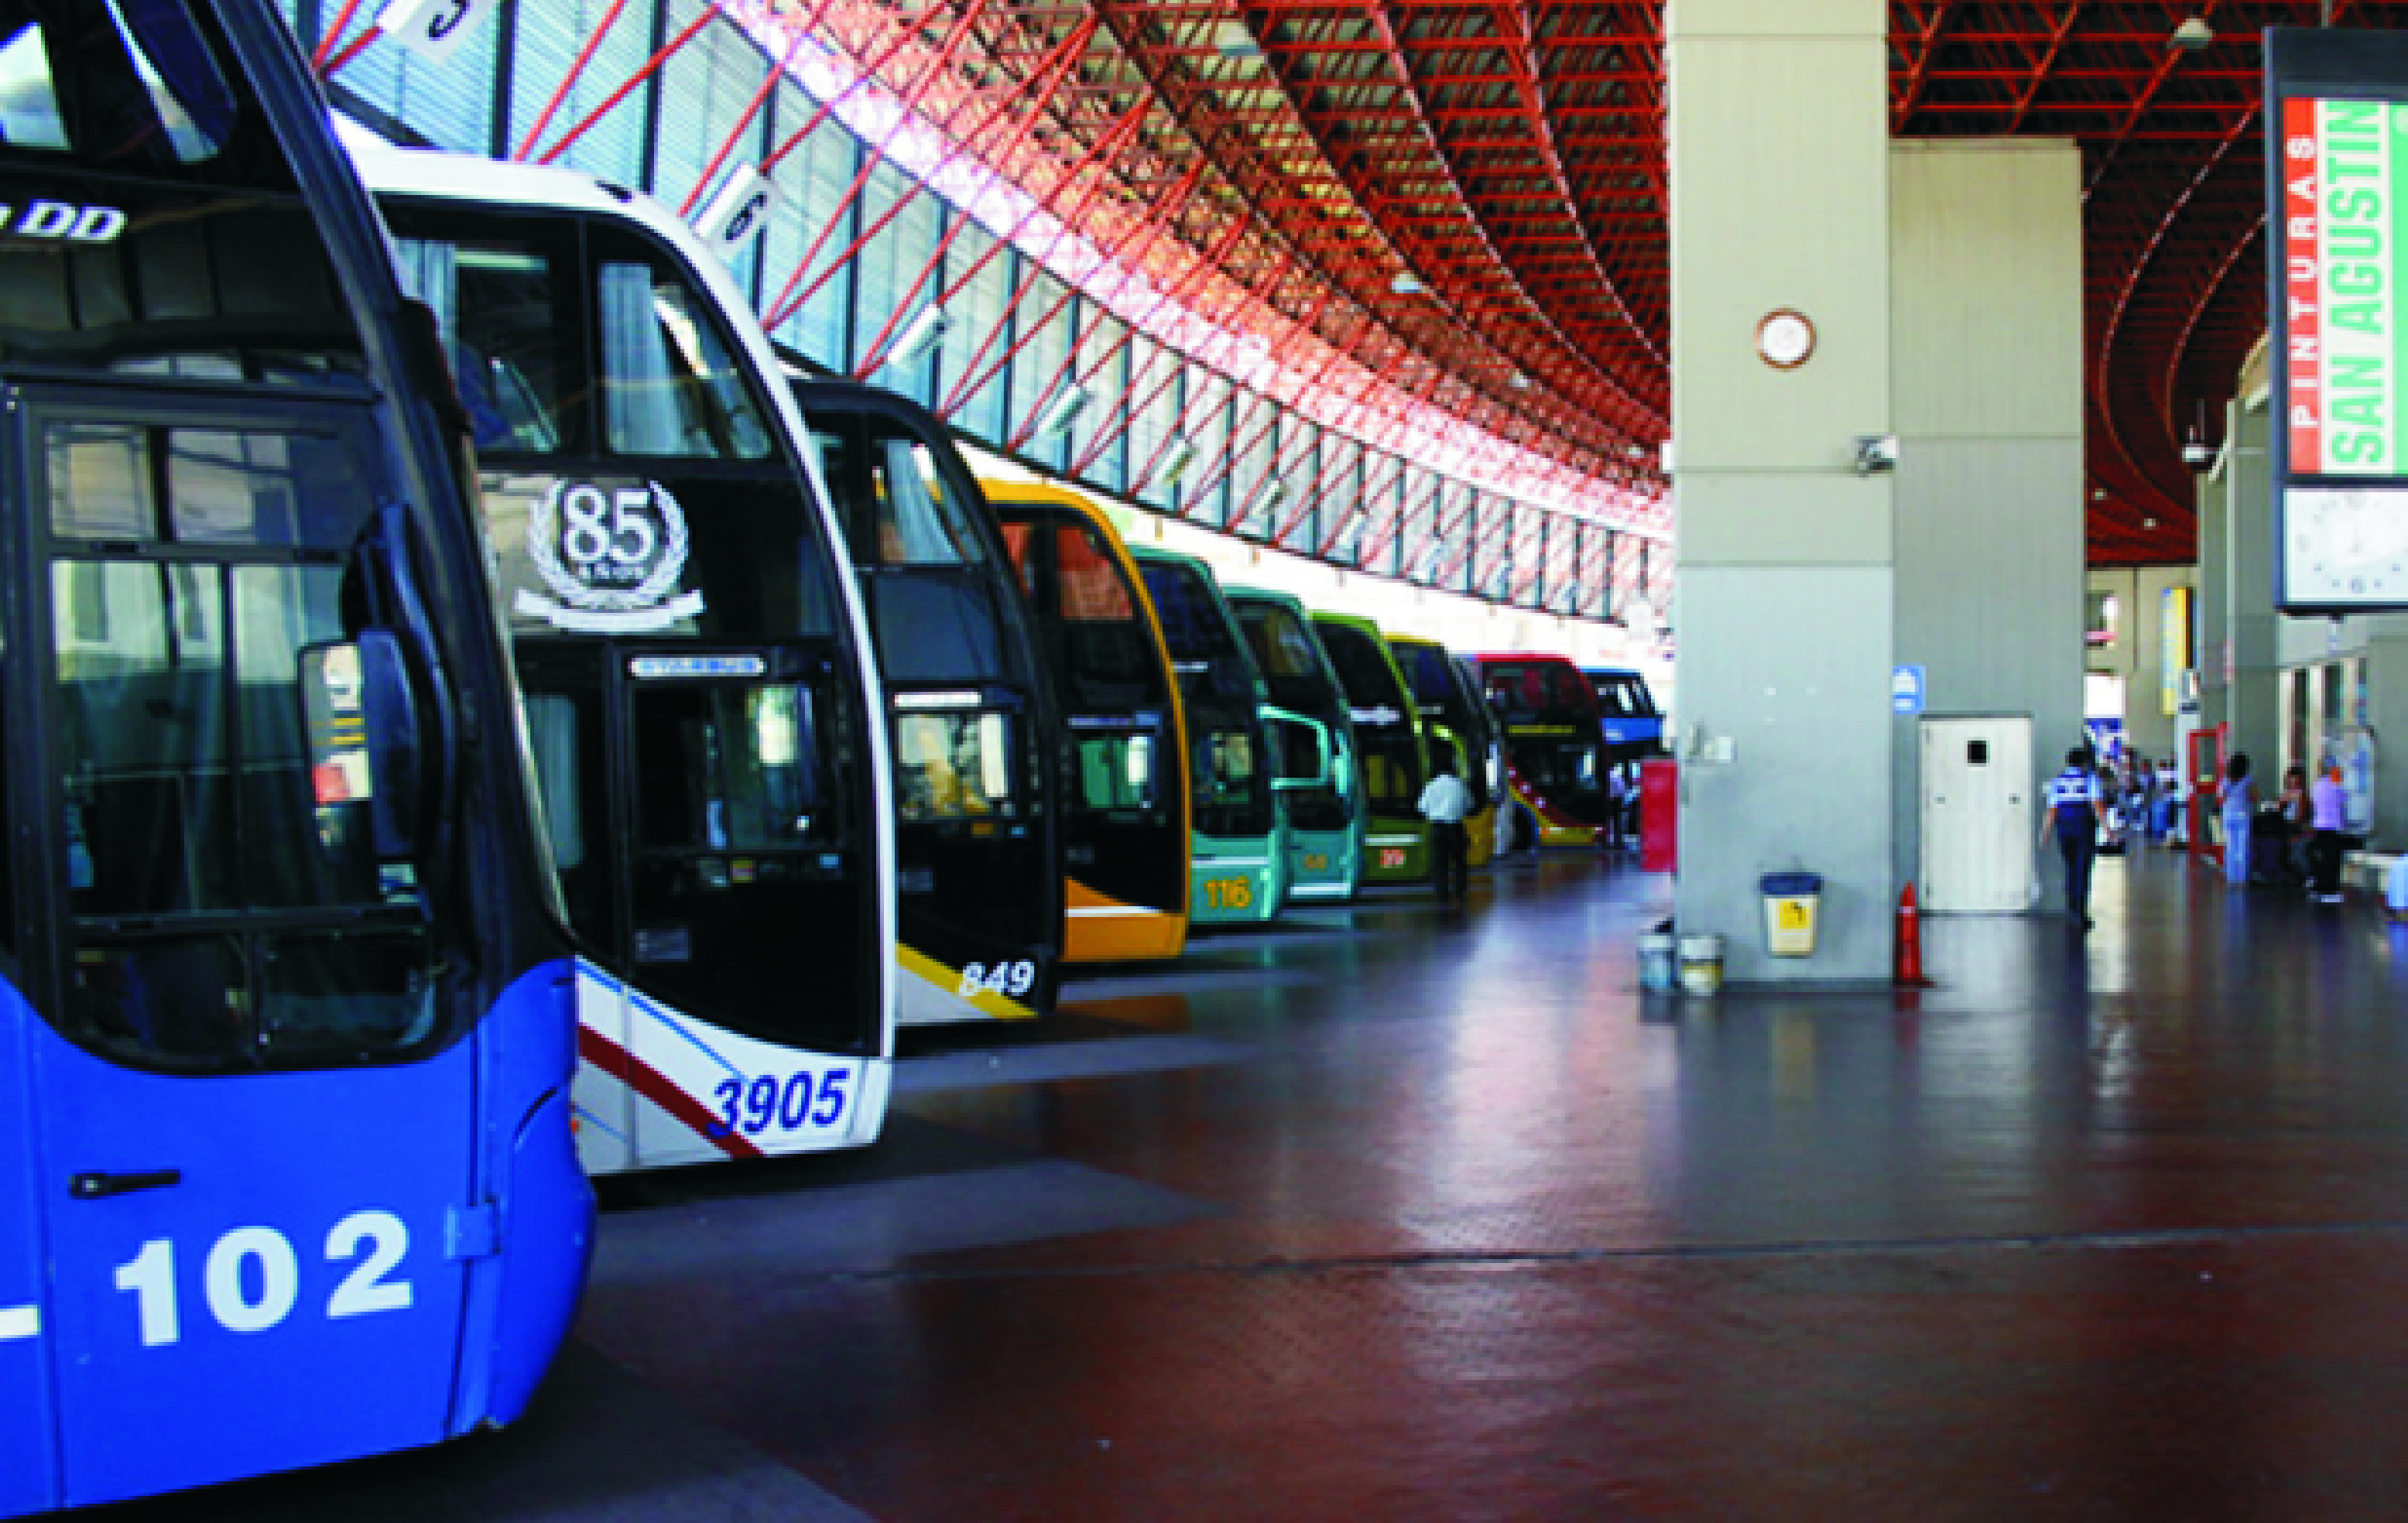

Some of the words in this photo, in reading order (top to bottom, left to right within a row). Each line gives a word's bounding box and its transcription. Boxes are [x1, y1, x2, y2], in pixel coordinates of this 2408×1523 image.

[17, 200, 127, 243] DD
[2325, 101, 2384, 337] AGUSTIN
[2286, 136, 2318, 427] PINTURAS
[2328, 352, 2386, 466] SAN
[563, 484, 655, 562] 85
[1204, 875, 1252, 910] 116
[957, 960, 1036, 997] 849
[705, 1067, 851, 1138] 3905
[113, 1208, 414, 1347] 102
